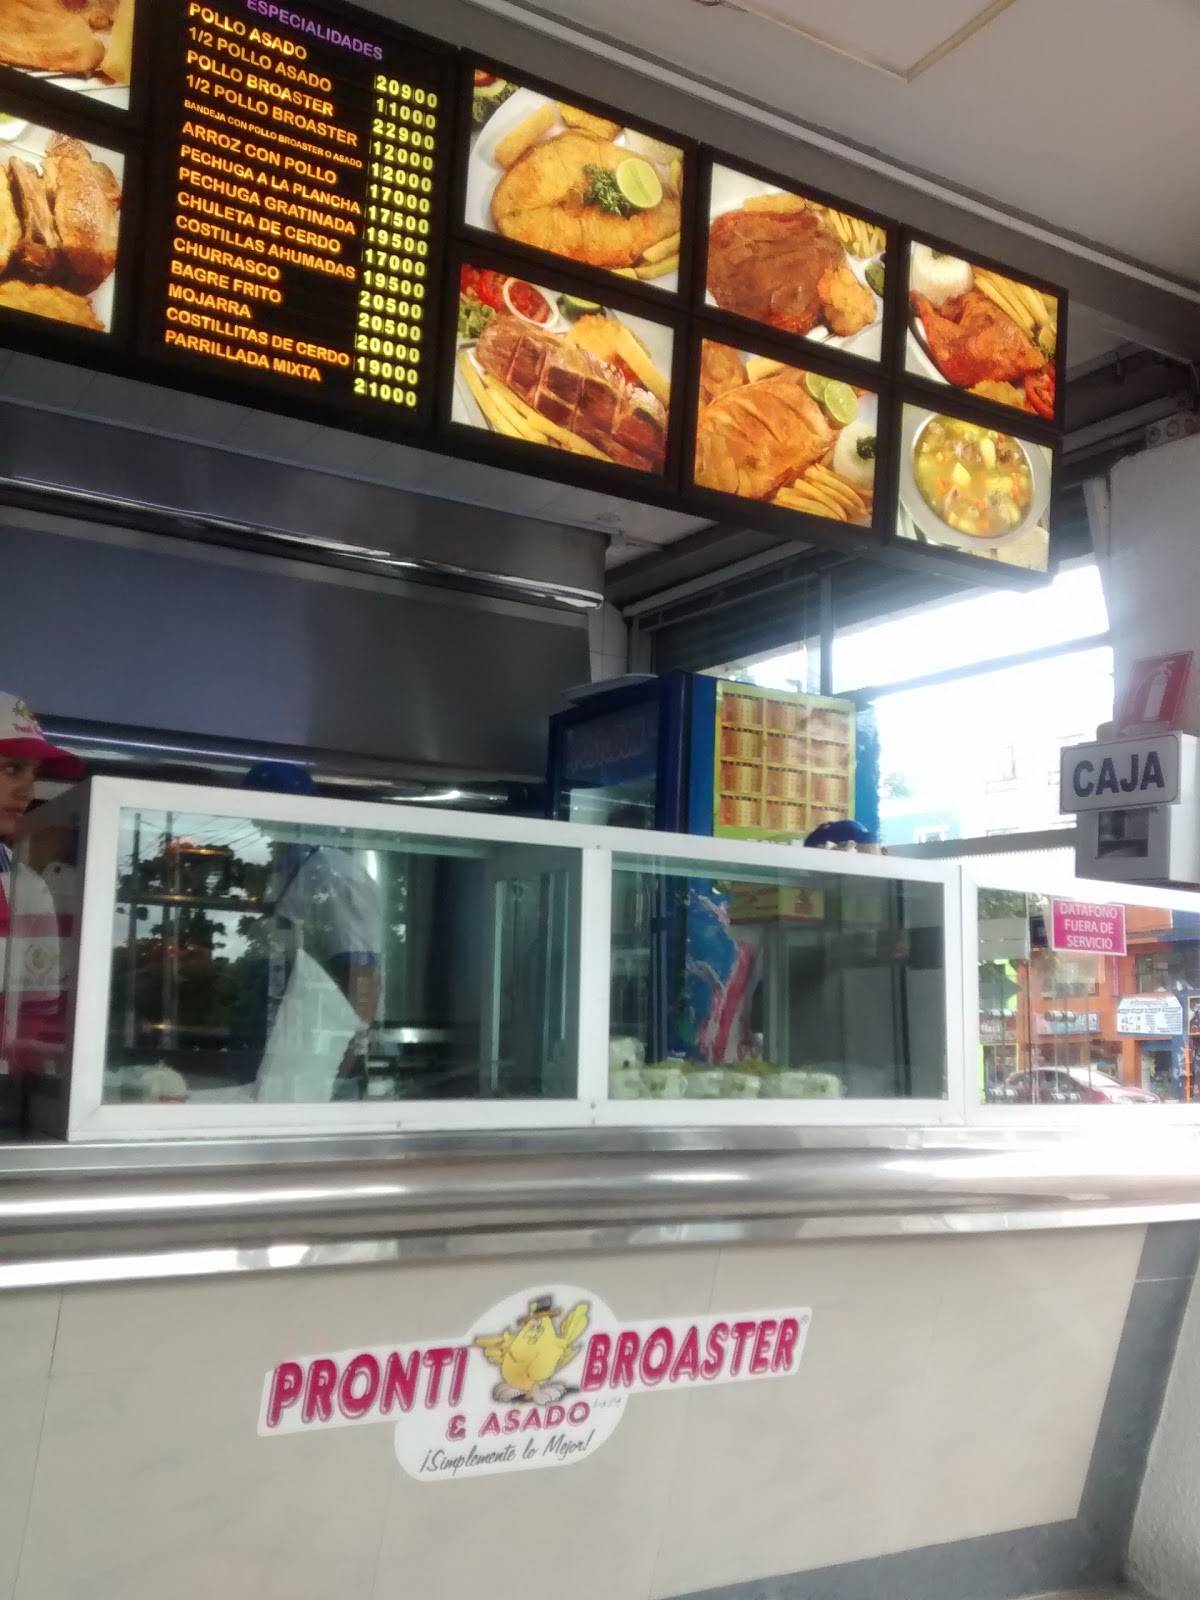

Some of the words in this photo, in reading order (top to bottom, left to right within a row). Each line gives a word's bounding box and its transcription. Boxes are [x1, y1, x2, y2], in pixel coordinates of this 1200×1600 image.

[189, 2, 246, 36] POLLO
[249, 28, 307, 60] ASADO
[246, 0, 383, 60] ESPECIALIDADES
[188, 26, 213, 48] 1/2
[217, 37, 272, 70] POLLO
[275, 61, 332, 92] ASADO
[187, 50, 243, 82] POLLO
[246, 73, 334, 117] BROASTER
[376, 74, 438, 108] 20900
[186, 74, 210, 94] 1/2
[214, 84, 269, 116] POLLO
[272, 106, 358, 147] BROASTER
[376, 97, 436, 130] 11000
[182, 121, 241, 153] ARROZ
[244, 143, 280, 166] CON
[284, 156, 337, 184] POLLO
[184, 99, 226, 122] BANDEJA
[227, 116, 248, 131] CON
[248, 123, 278, 140] POLLO
[278, 134, 324, 156] BROASTER
[324, 150, 332, 159] O
[333, 153, 363, 168] ASADO
[372, 118, 435, 150] 22900
[373, 140, 433, 170] 12000
[181, 144, 254, 181] PECHUGA
[257, 171, 268, 186] A
[271, 175, 290, 193] LA
[293, 182, 361, 215] PLANCHA
[371, 162, 432, 192] 12000
[179, 166, 260, 207] PECHUGA
[264, 196, 356, 236] GRATINADA
[370, 183, 430, 213] 17000
[177, 191, 255, 228] CHULETA
[259, 217, 281, 236] DE
[284, 225, 341, 253] CERDO
[368, 205, 429, 234] 17500
[173, 237, 280, 280] CHURRASCO
[175, 215, 265, 253] COSTILLAS
[268, 243, 356, 279] AHUMADAS
[367, 226, 428, 256] 19500
[171, 259, 229, 290] BAGRE
[233, 278, 282, 303] FRITO
[365, 248, 426, 276] 17000
[168, 283, 252, 319] MOJARRA
[363, 270, 424, 298] 19500
[360, 290, 422, 320] 20500
[166, 306, 268, 345] COSTILLITAS
[271, 334, 293, 352] DE
[296, 341, 350, 366] CERDO
[358, 312, 421, 342] 20500
[165, 329, 270, 369] PARRILLADA
[273, 357, 322, 382] MIXTA
[357, 334, 420, 363] 20000
[356, 356, 418, 386] 19000
[354, 377, 417, 407] 21000
[1072, 751, 1165, 798] CAJA
[1064, 918, 1098, 933] FUERA
[1100, 921, 1114, 935] DE
[1066, 935, 1113, 950] SERVICIO
[266, 1346, 469, 1429] PRONTI
[581, 1316, 799, 1393] BROASTER
[446, 1414, 467, 1441] &
[478, 1401, 590, 1438] ASADO
[420, 1443, 516, 1477] ¡Simplemente
[522, 1437, 537, 1460] lo
[542, 1427, 596, 1462] Mejor!
